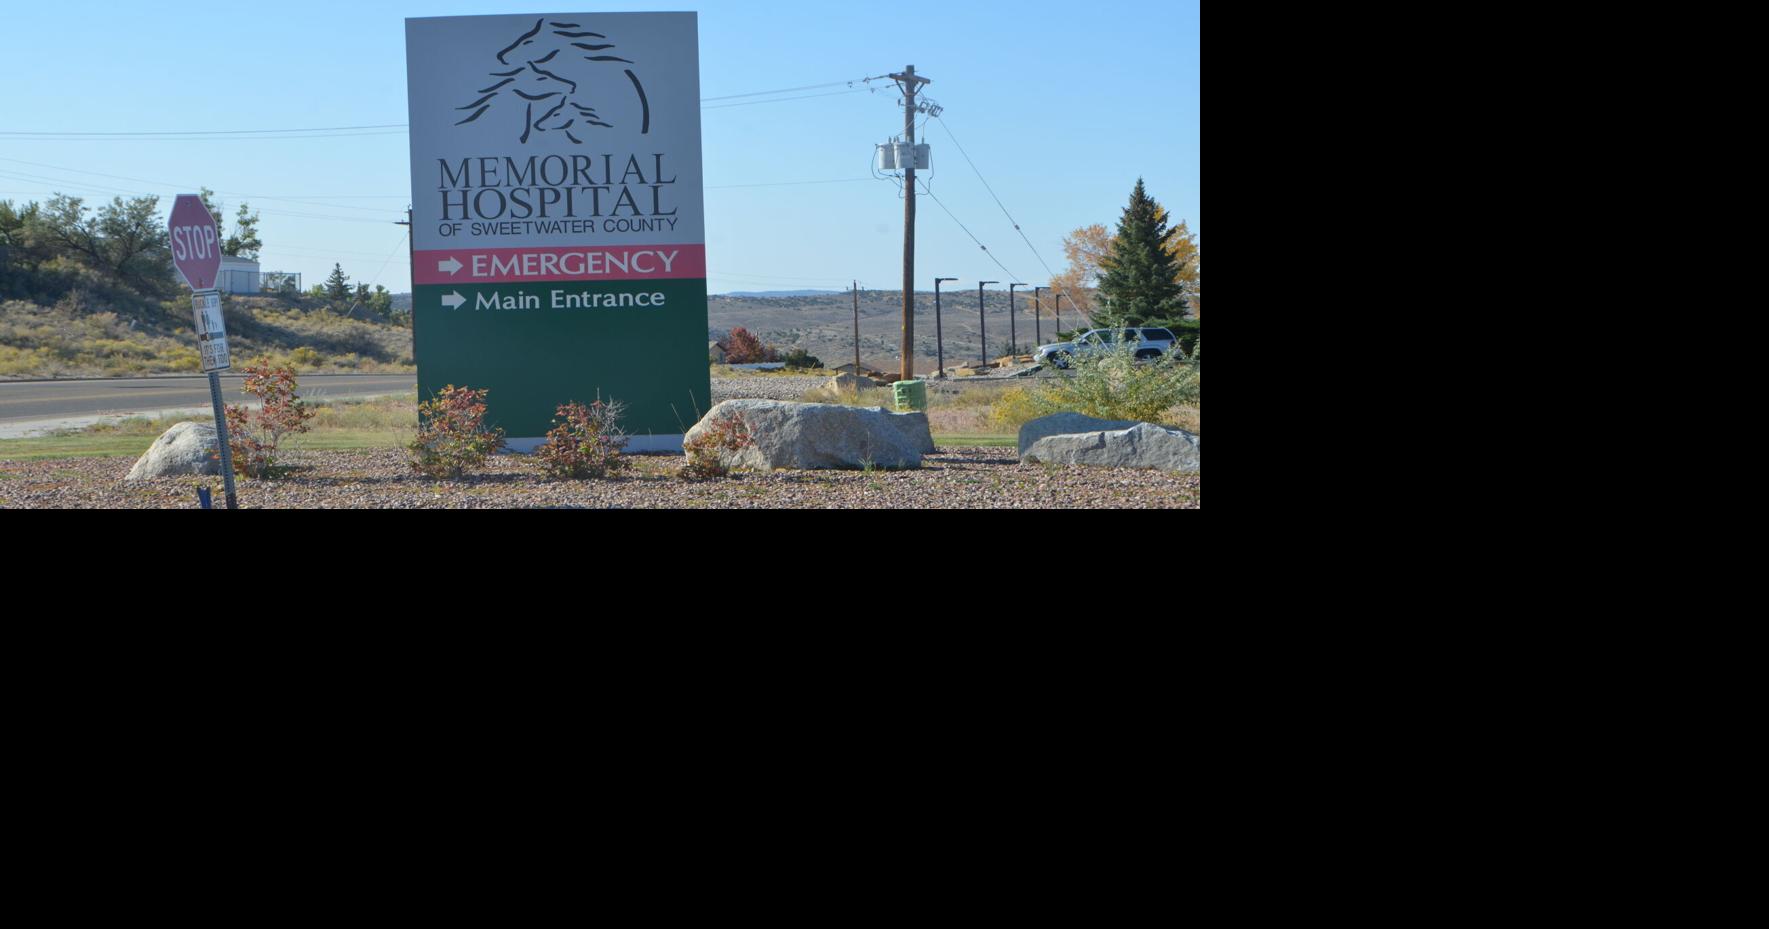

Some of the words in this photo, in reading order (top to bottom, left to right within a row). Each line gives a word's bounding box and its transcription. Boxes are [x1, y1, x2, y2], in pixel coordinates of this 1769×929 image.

[437, 153, 677, 189] MEMORIAL
[437, 185, 678, 221] HOSPITAL
[438, 223, 462, 237] OF
[471, 219, 595, 236] SWEETWATER
[603, 217, 678, 233] COUNTY
[173, 225, 215, 261] STOP
[471, 250, 679, 277] EMERGENCY
[475, 291, 540, 311] Main
[551, 289, 665, 309] Entrance
